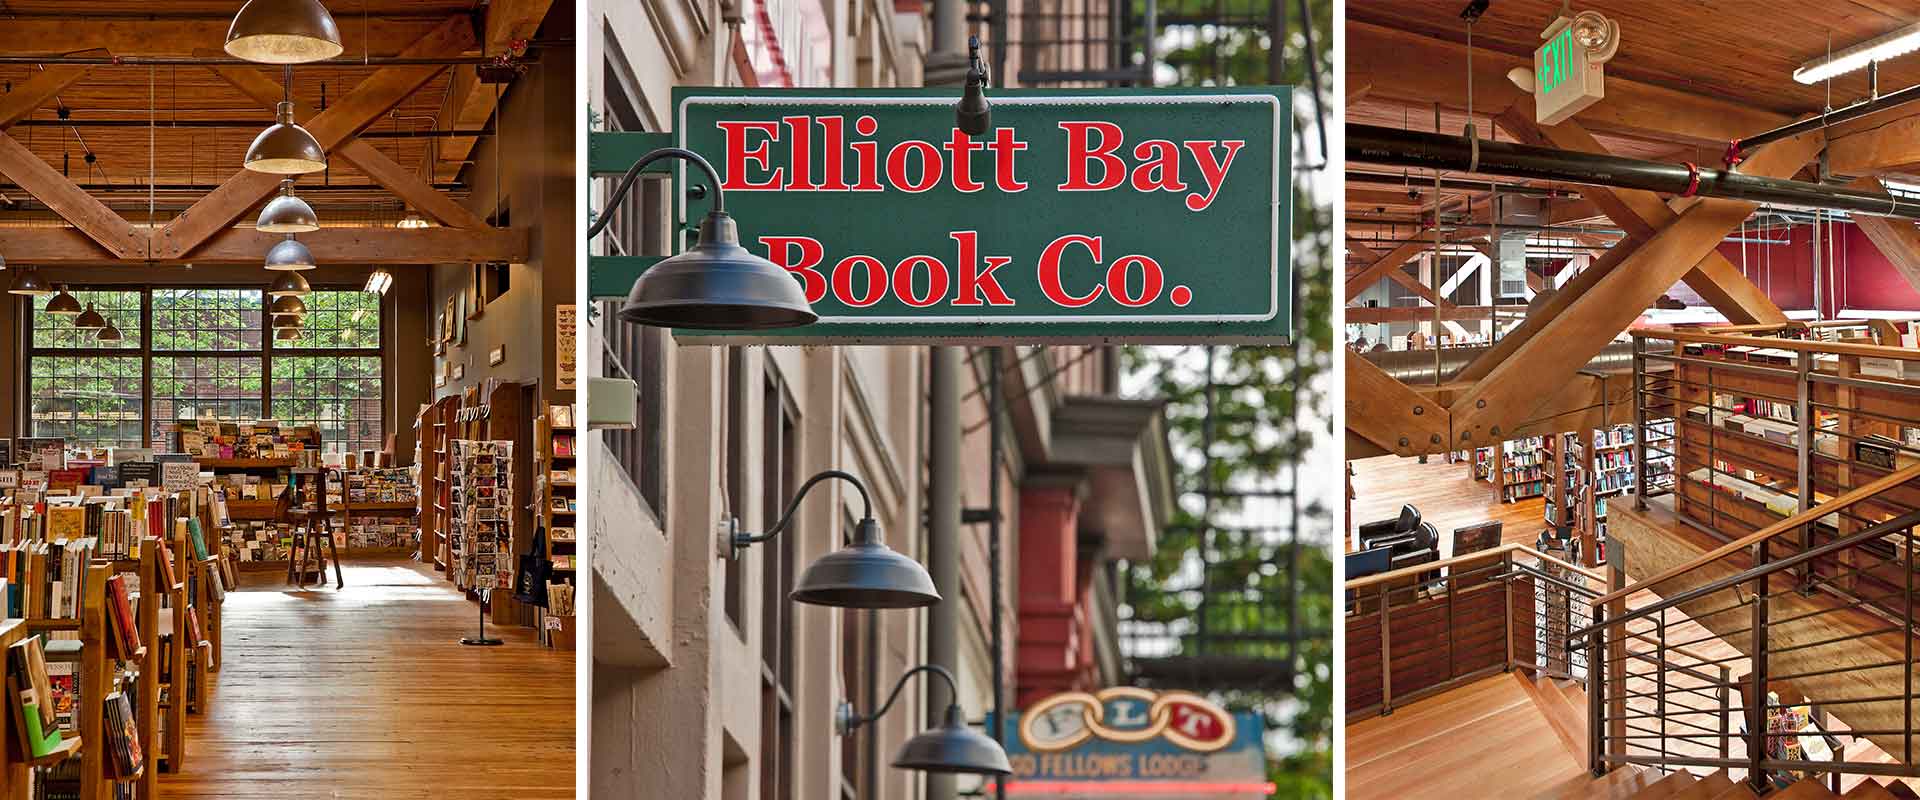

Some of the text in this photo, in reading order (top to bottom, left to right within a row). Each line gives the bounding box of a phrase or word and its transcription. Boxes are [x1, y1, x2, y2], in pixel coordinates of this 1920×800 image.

[1543, 28, 1573, 93] EXIT
[716, 114, 1245, 212] Elliott Bay
[758, 230, 1193, 308] Book Co.
[1040, 752, 1133, 777] FELLOWS
